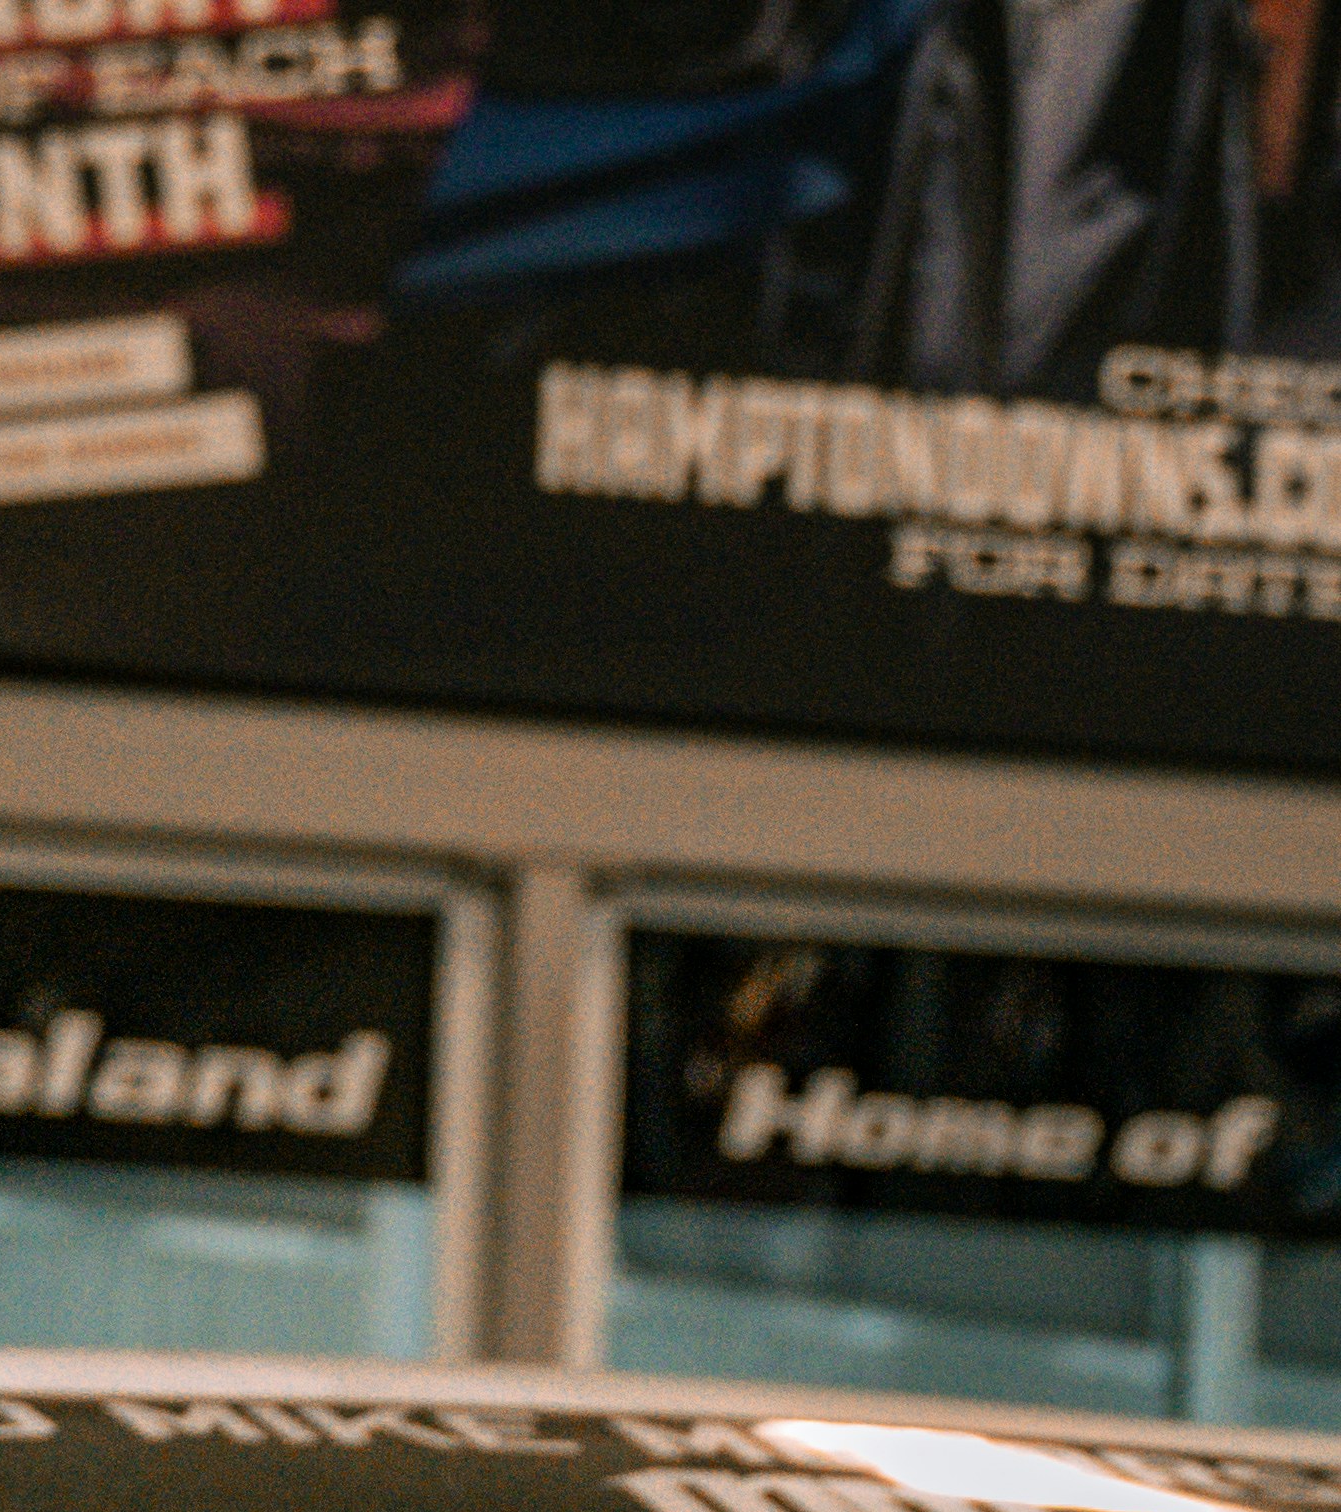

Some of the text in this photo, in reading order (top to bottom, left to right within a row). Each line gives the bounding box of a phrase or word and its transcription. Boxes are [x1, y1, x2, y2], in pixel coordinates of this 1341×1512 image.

[91, 17, 404, 116] EACH
[888, 523, 1093, 598] FOR
[719, 1061, 1283, 1191] Home of
[106, 1400, 582, 1456] MIKE
